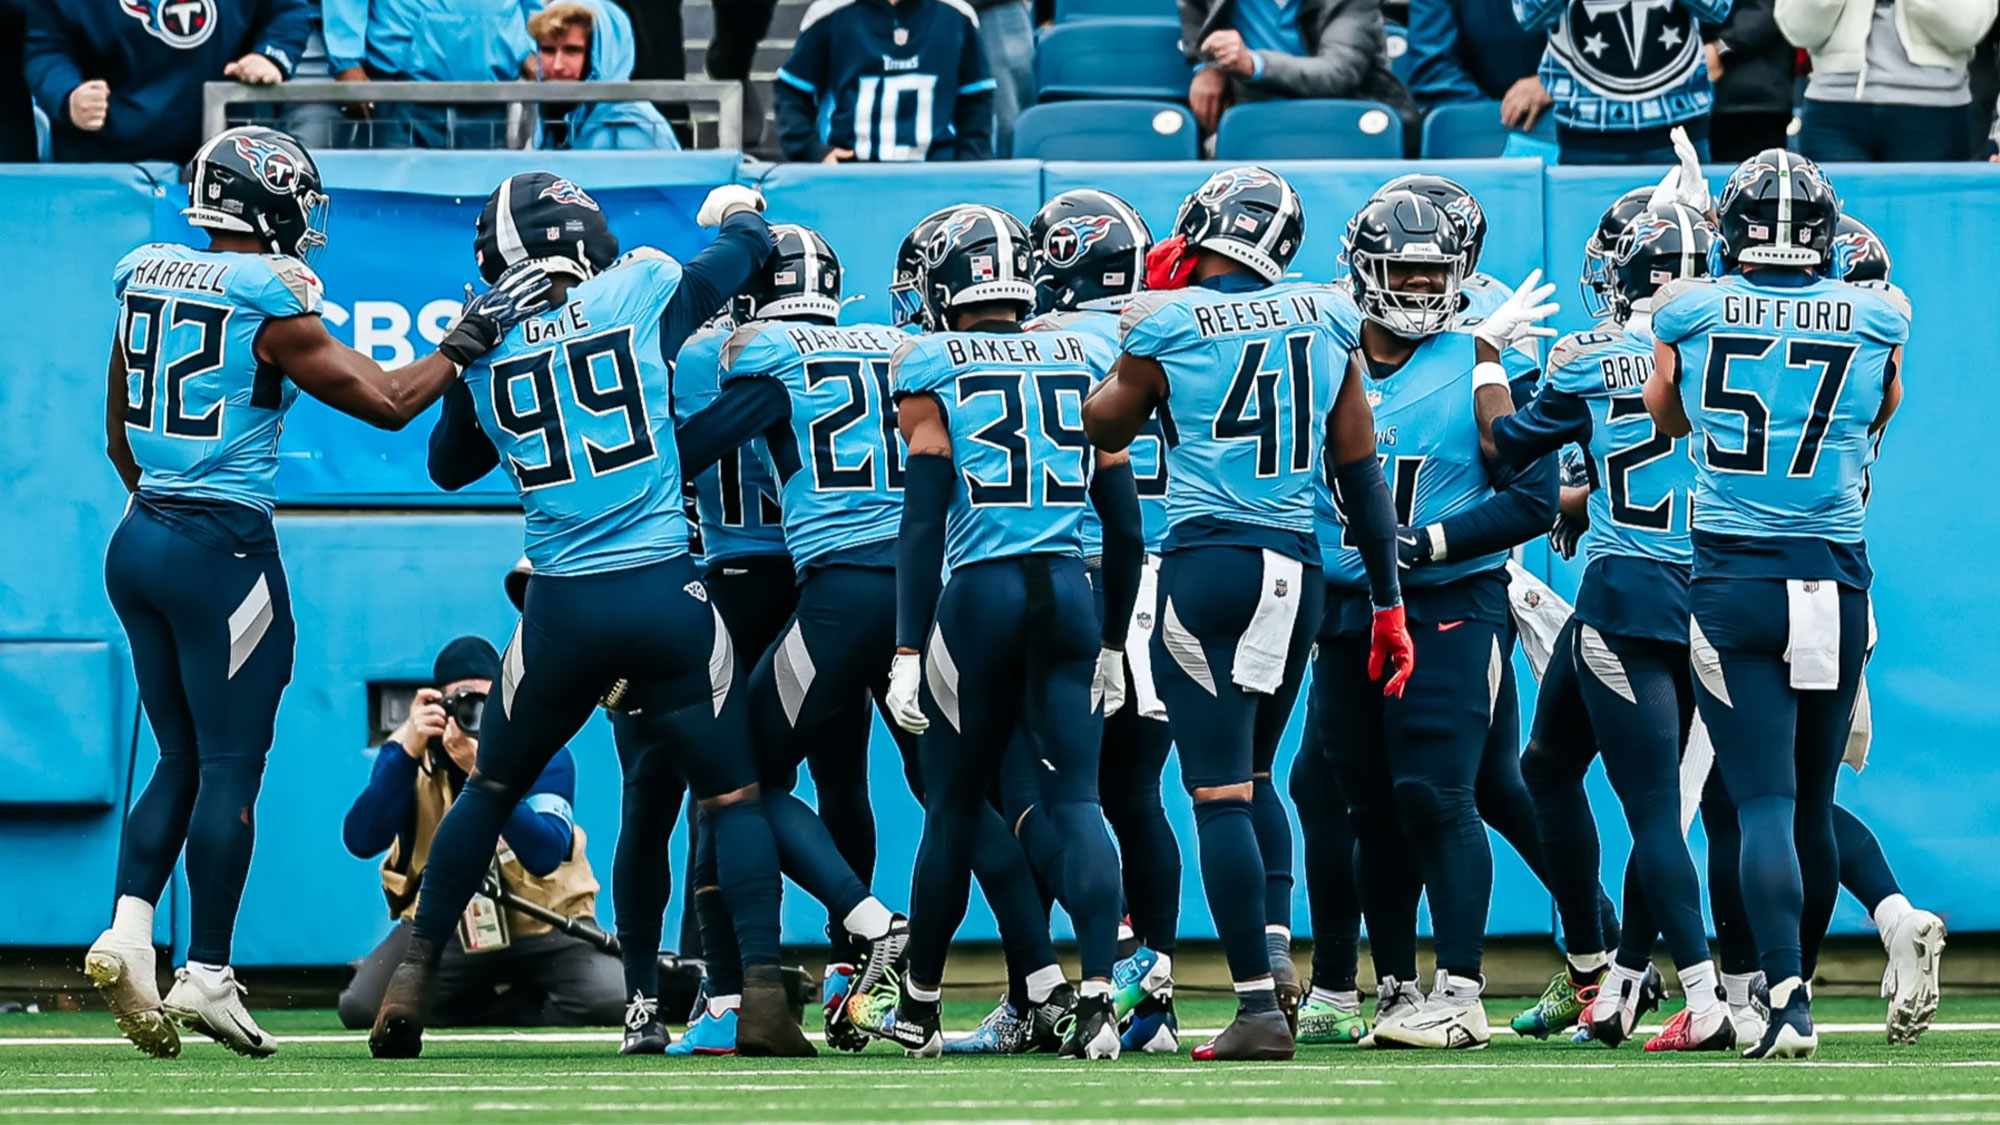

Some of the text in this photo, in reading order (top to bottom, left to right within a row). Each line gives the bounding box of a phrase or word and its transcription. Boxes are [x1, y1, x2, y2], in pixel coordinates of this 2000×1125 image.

[854, 73, 938, 161] 10
[134, 259, 229, 295] HARRELL
[1723, 295, 1853, 333] GIFFORD
[321, 299, 464, 372] BS
[523, 299, 591, 346] GAYE
[946, 336, 1086, 368] BAKER JR
[1192, 296, 1320, 339] REESE IV
[124, 291, 235, 440] 92
[1212, 331, 1315, 479] 41
[1600, 355, 1655, 390] BRO
[1701, 332, 1862, 479] 57
[490, 324, 659, 492] 99
[956, 370, 1094, 508] 39
[1604, 394, 1693, 533] 2
